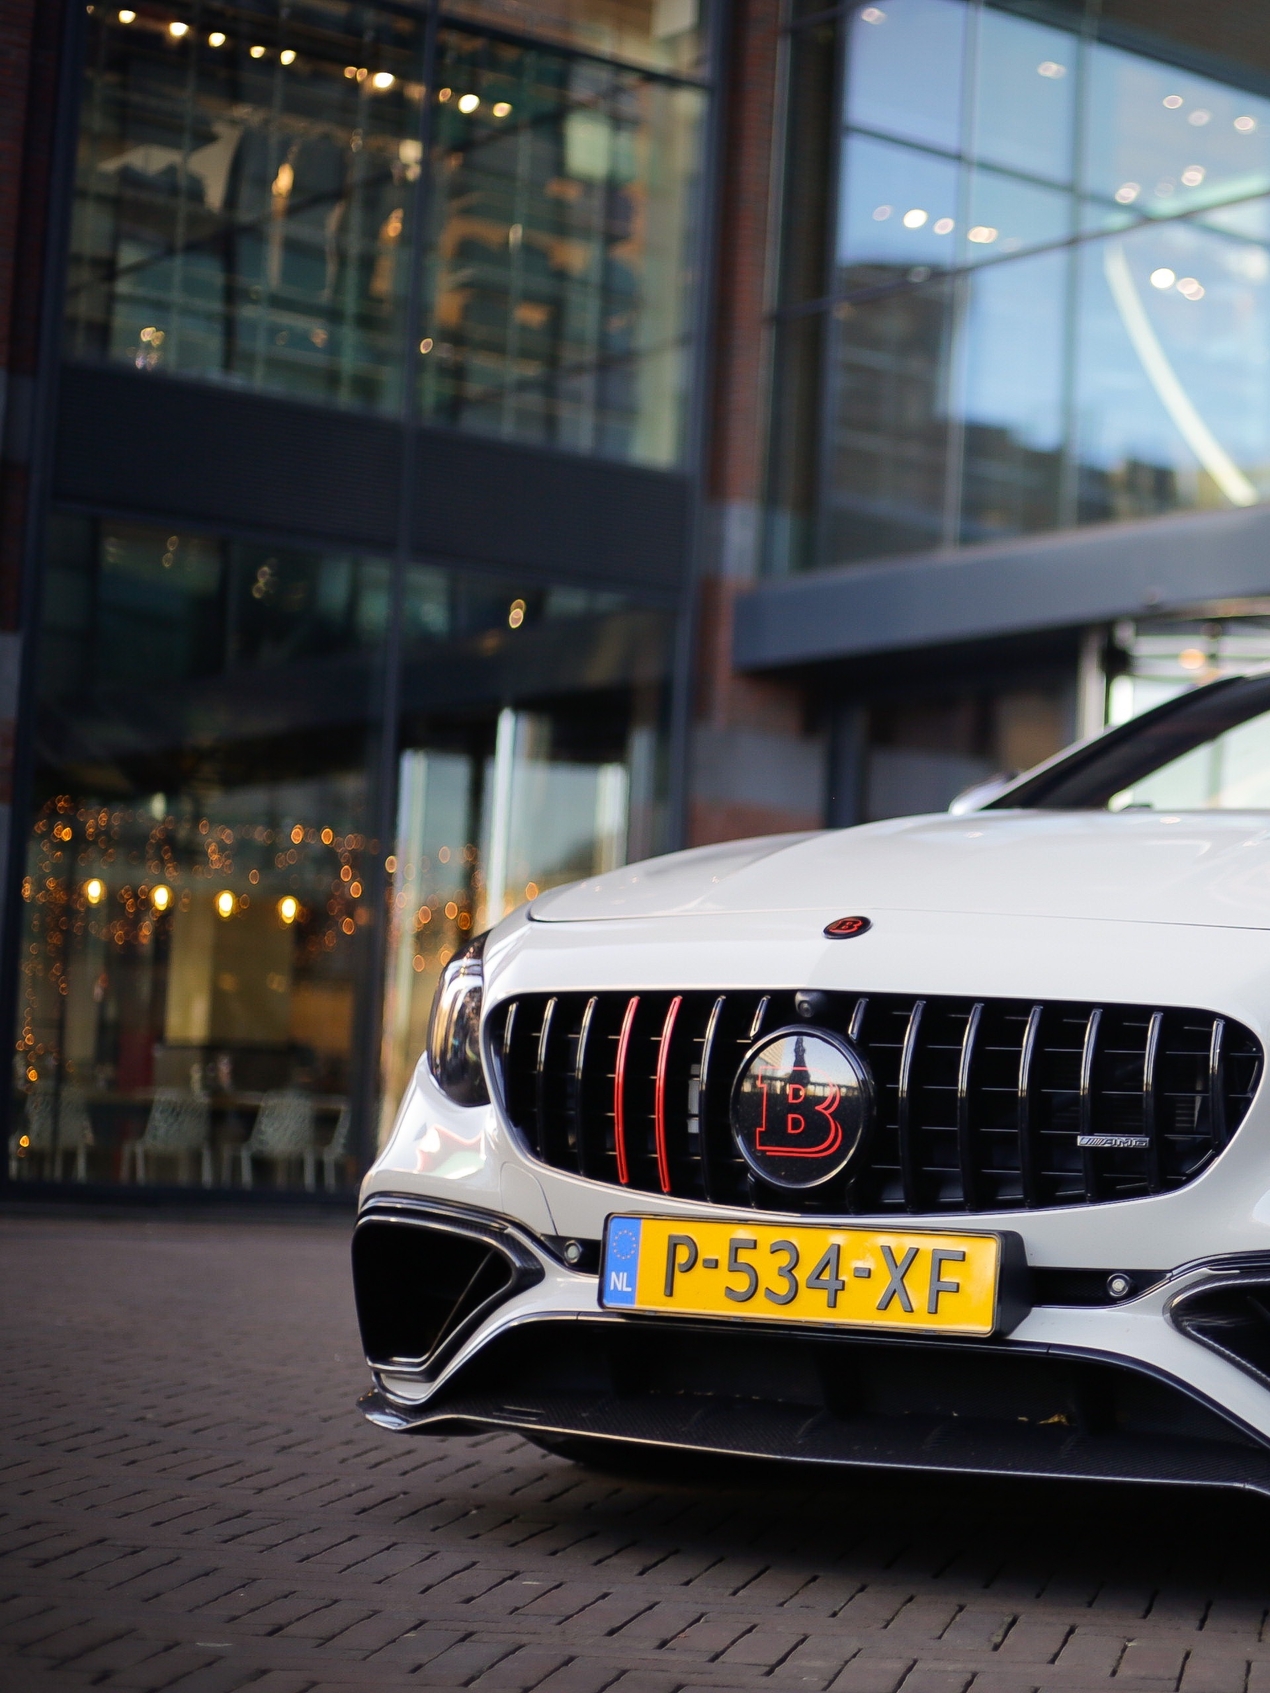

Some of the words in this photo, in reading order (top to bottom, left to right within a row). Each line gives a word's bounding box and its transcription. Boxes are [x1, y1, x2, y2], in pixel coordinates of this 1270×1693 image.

[829, 918, 864, 934] B
[756, 1066, 843, 1158] B
[610, 1271, 632, 1292] NL
[664, 1234, 966, 1314] P-534-XF
